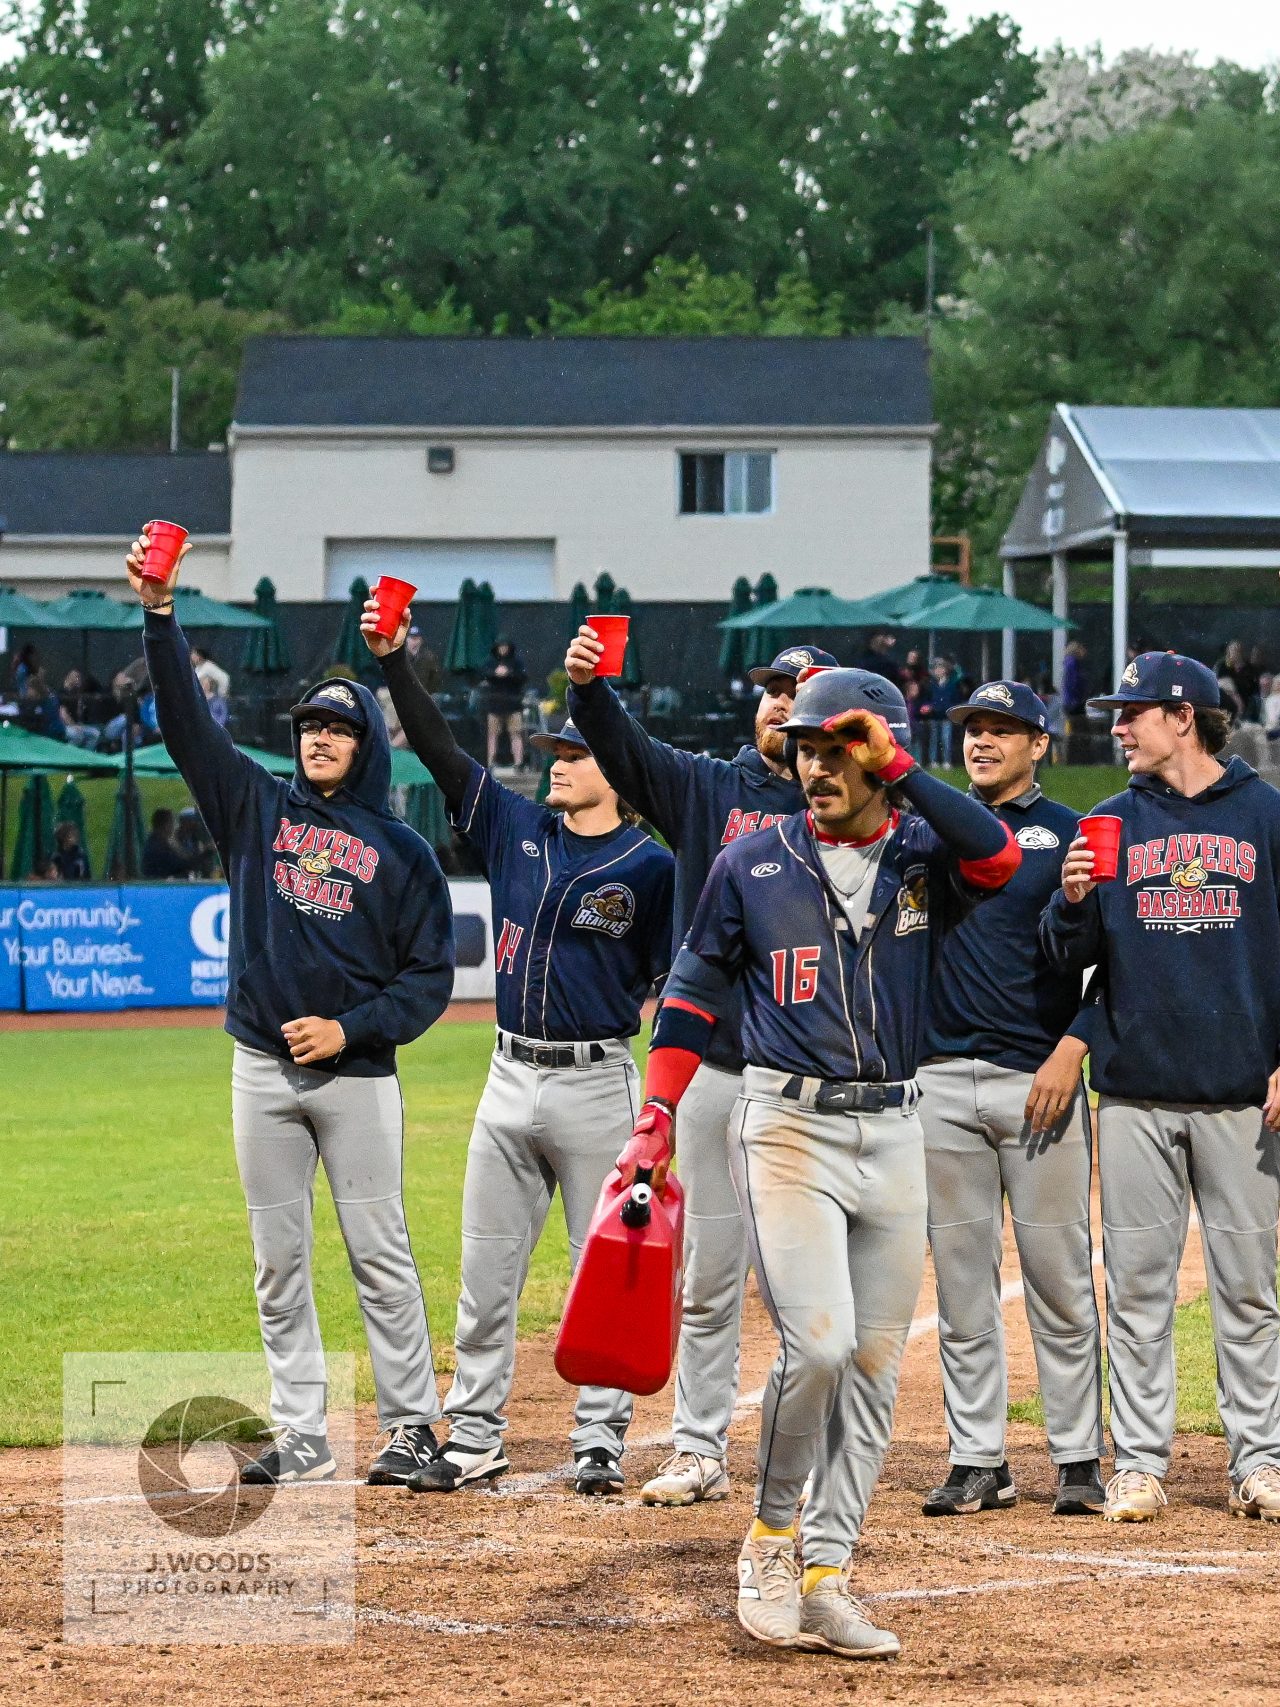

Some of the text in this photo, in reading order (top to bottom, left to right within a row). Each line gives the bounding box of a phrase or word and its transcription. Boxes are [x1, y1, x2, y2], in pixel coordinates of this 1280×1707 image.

[272, 818, 379, 883] BEAVERS
[1126, 834, 1257, 886] BEAVERS
[1137, 890, 1241, 917] BASEBALL
[574, 908, 630, 935] BEAVERS
[3, 937, 48, 967] Your
[496, 917, 524, 974] 14
[46, 970, 89, 998] Your
[770, 945, 821, 1006] 16
[962, 1470, 994, 1502] METCON
